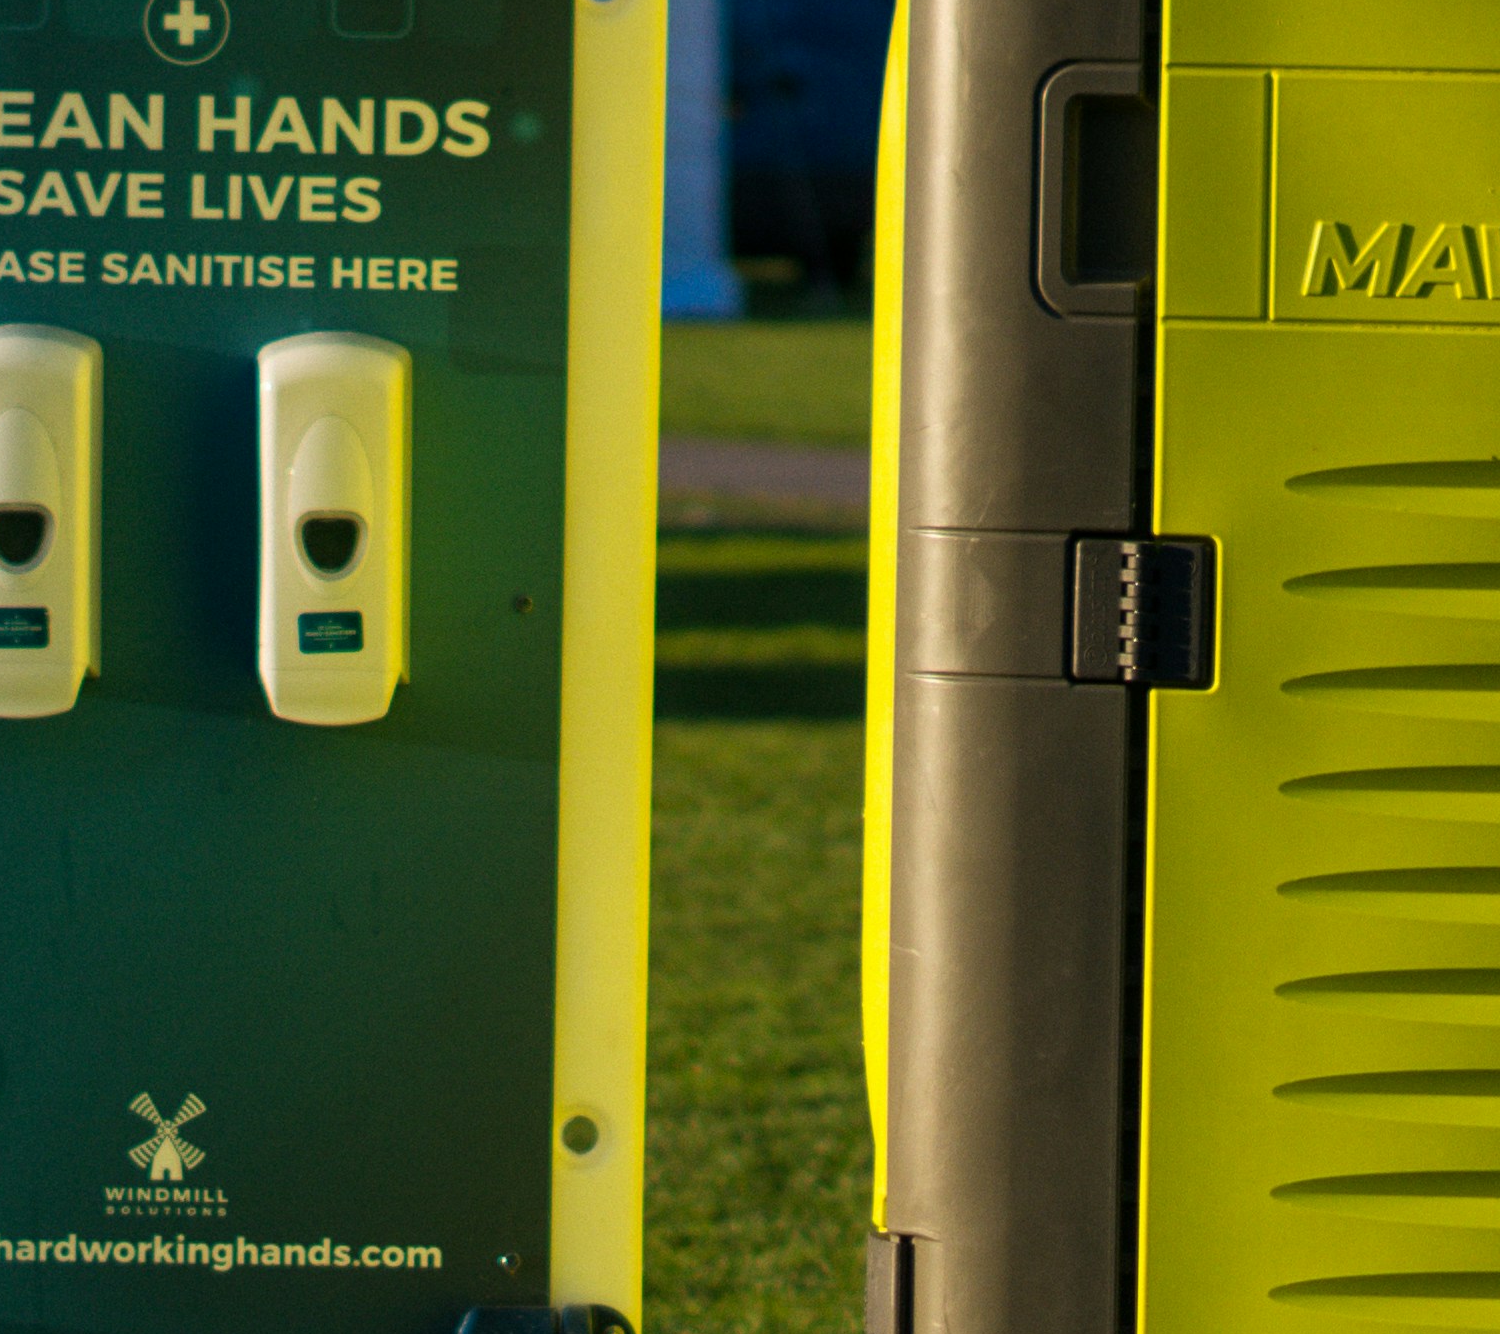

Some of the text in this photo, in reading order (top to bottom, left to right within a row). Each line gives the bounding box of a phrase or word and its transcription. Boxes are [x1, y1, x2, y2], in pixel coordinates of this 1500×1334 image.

[197, 94, 491, 159] HANDS
[190, 173, 382, 224] LIVES
[100, 251, 316, 290] SANITISE
[331, 256, 459, 293] HERE
[104, 1186, 230, 1205] WINDMILL
[104, 1205, 228, 1218] SOLUTIONS
